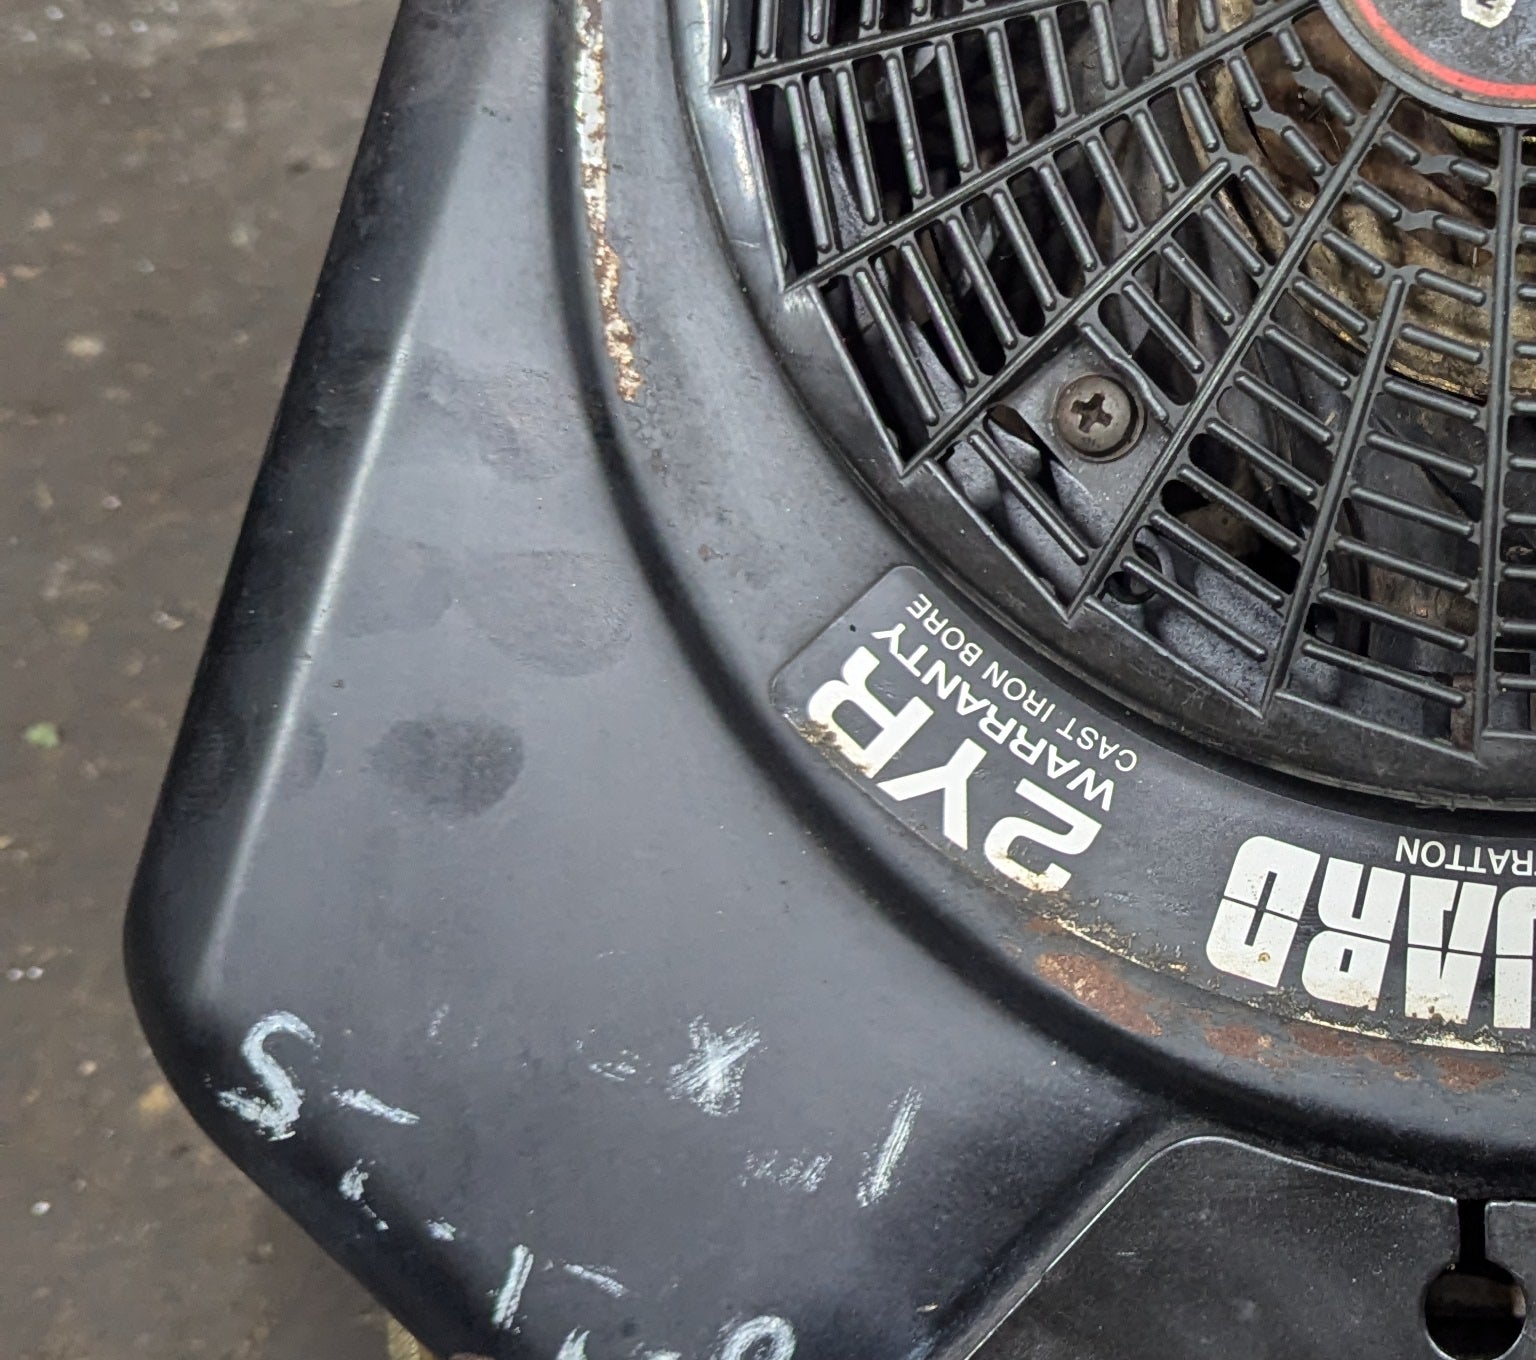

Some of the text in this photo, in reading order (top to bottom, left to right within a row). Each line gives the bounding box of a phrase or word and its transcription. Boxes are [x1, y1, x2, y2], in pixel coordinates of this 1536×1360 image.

[871, 623, 1115, 811] WARRANTY
[905, 593, 1138, 772] CAST IRON BORE
